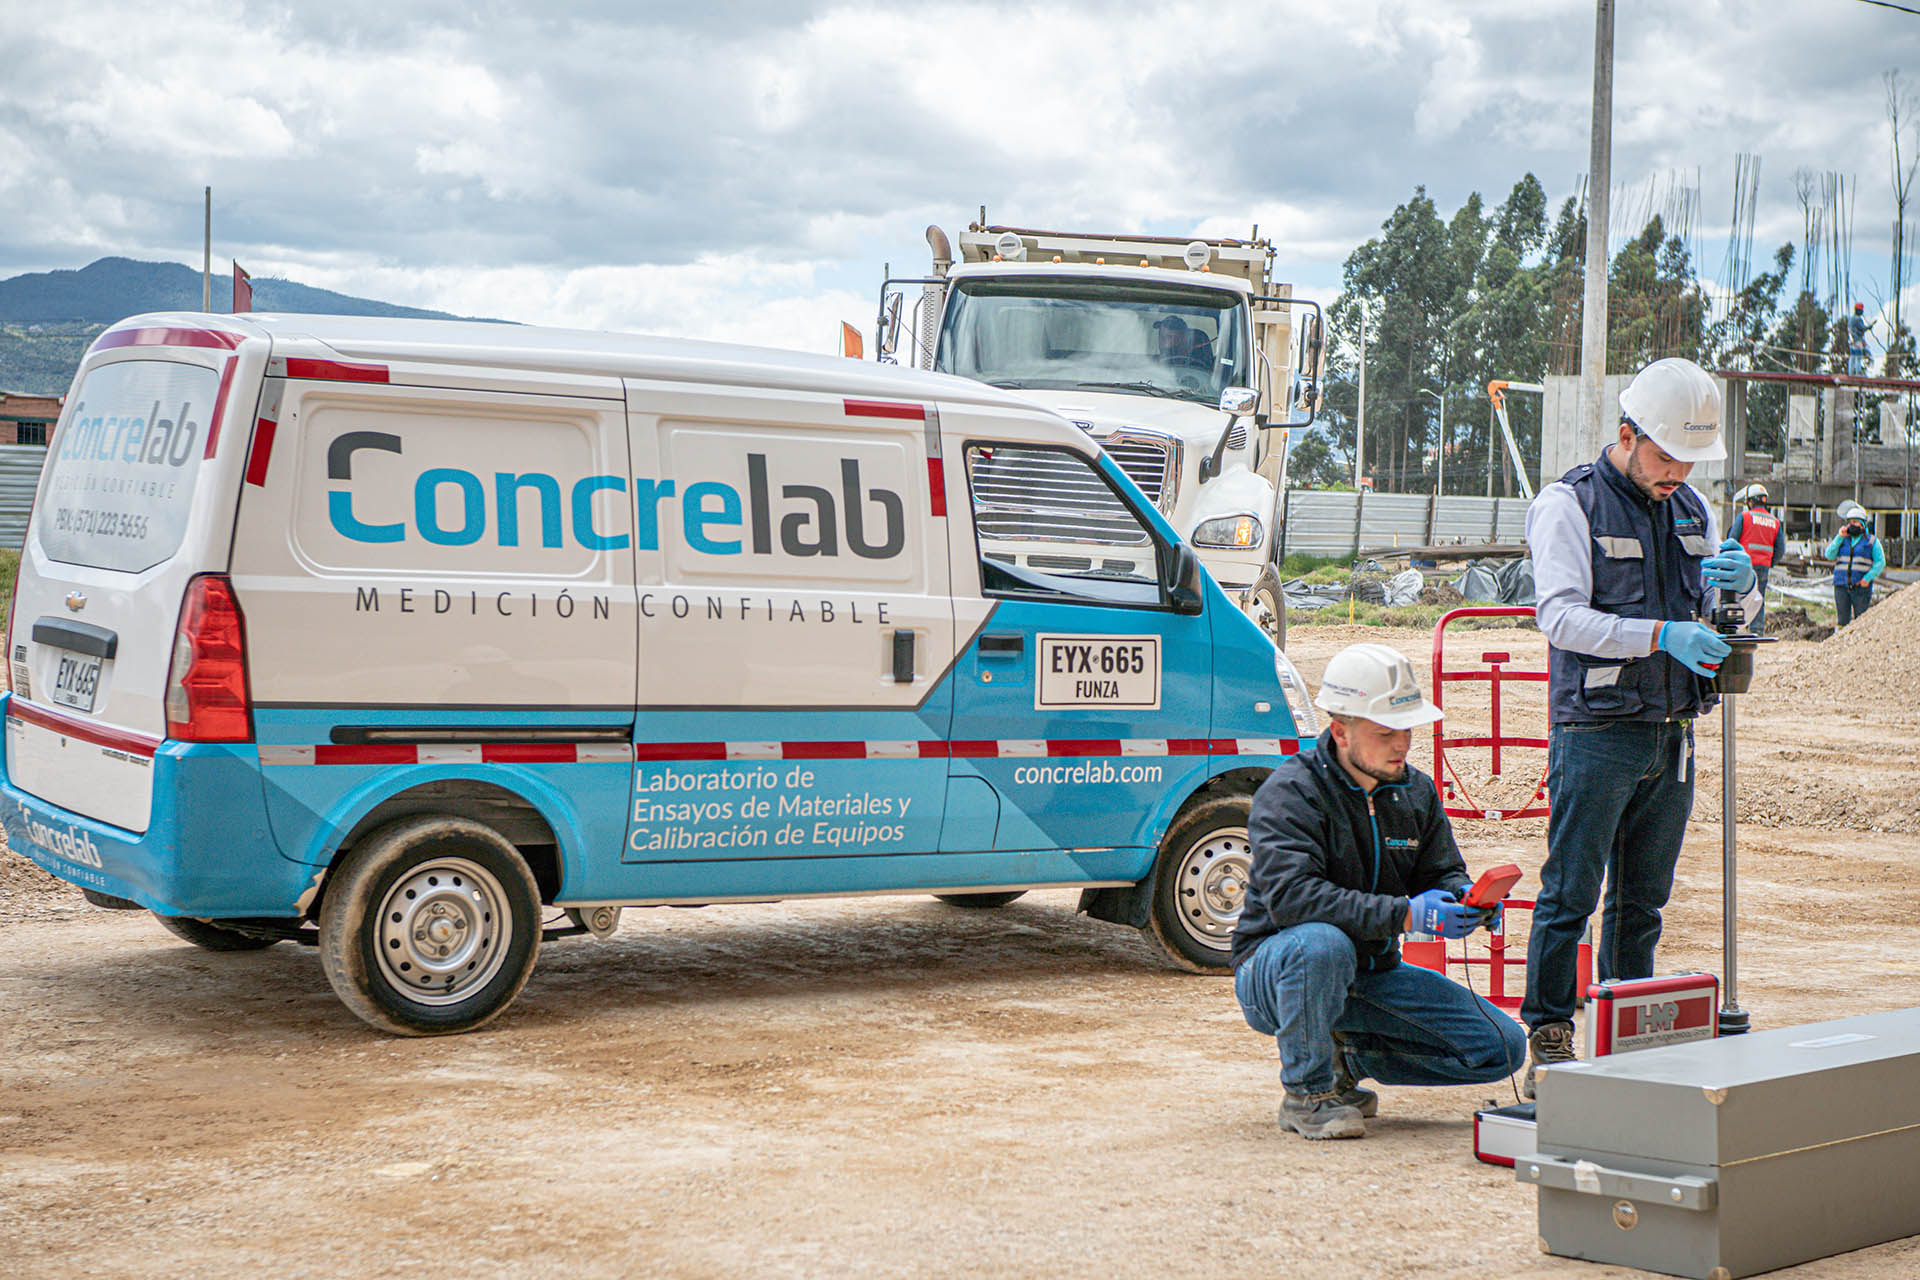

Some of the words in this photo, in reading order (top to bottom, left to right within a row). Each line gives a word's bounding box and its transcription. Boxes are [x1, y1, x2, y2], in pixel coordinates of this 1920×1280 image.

[327, 430, 905, 560] Concrelab
[96, 511, 118, 536] 223
[355, 586, 610, 621] MEDICIÓN
[639, 594, 891, 625] CONFIABLE
[1075, 680, 1119, 699] FUNZA
[635, 765, 778, 793] Laboratorio
[785, 765, 815, 789] de
[1014, 760, 1162, 784] concrelab.com
[633, 798, 733, 824] Ensayos
[740, 796, 770, 818] de
[778, 792, 892, 817] Materiales
[898, 797, 911, 818] y
[629, 824, 768, 851] Calibración
[774, 823, 805, 845] de
[812, 821, 905, 847] Equipos
[1637, 1001, 1680, 1035] HMP
